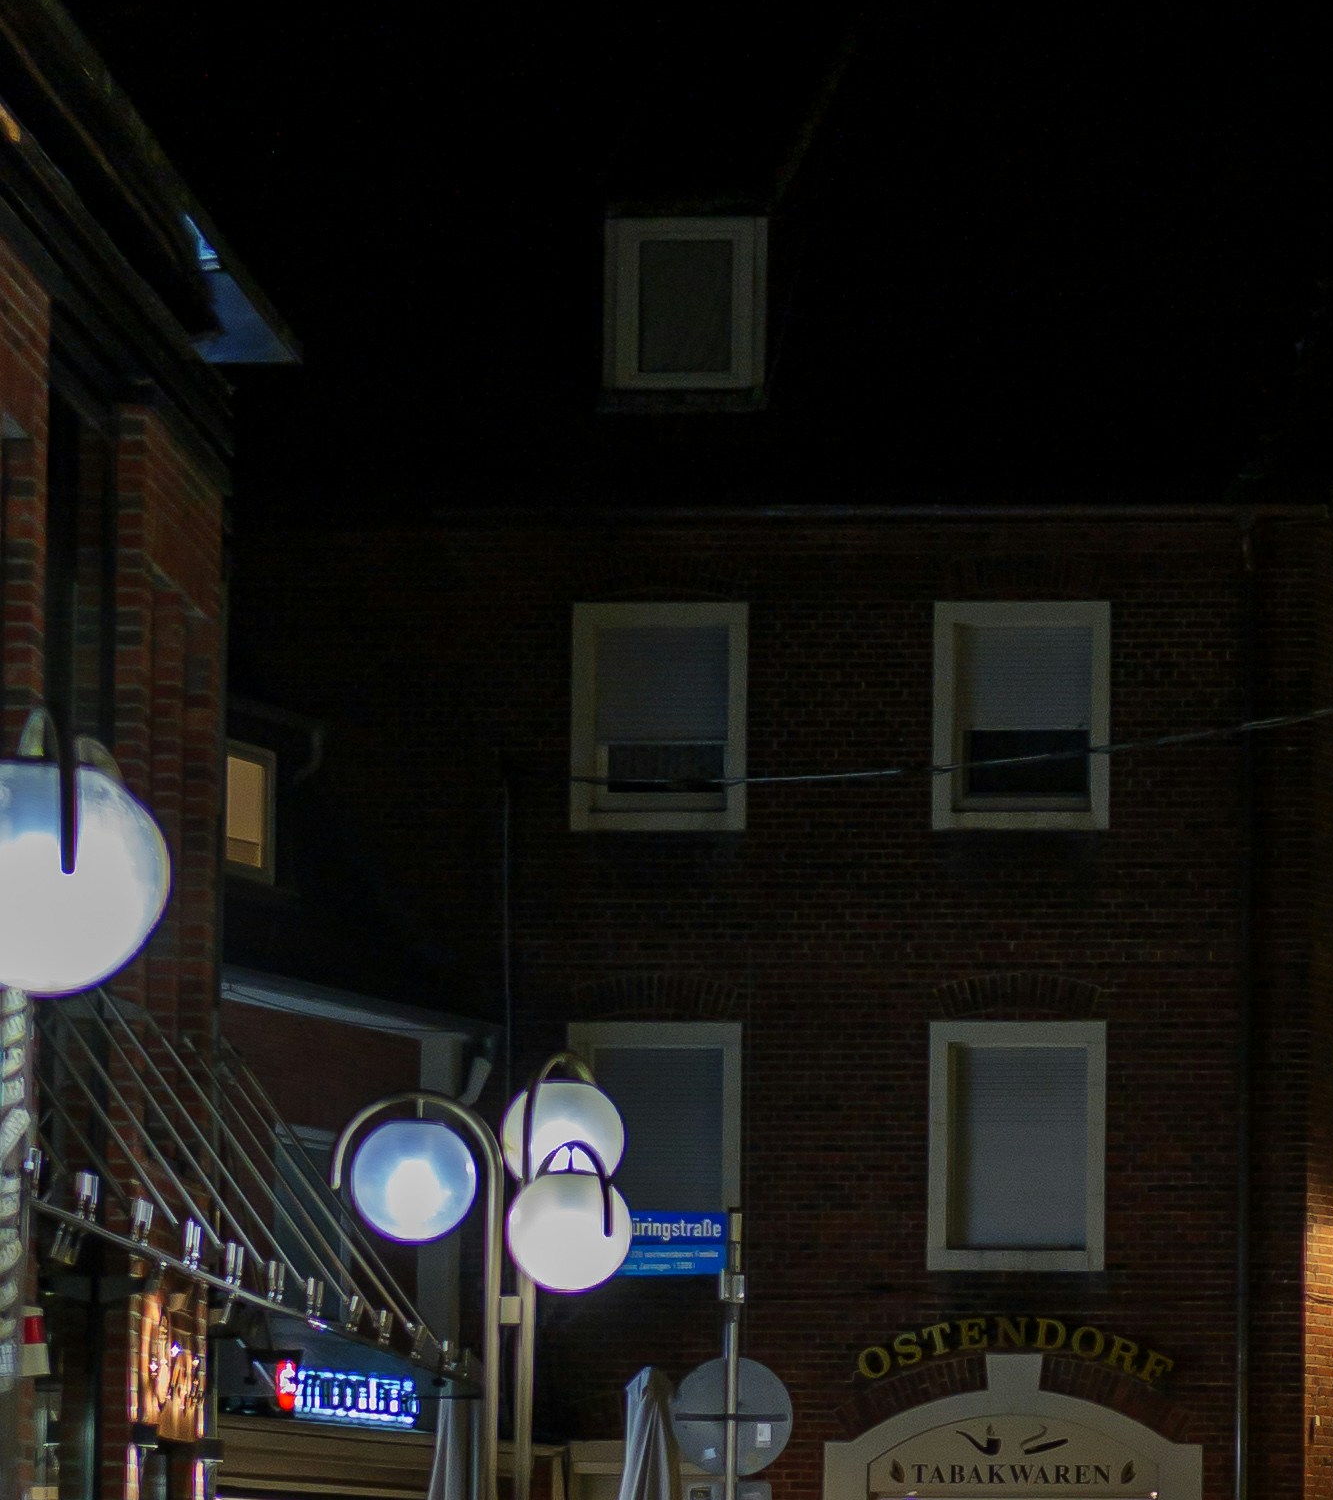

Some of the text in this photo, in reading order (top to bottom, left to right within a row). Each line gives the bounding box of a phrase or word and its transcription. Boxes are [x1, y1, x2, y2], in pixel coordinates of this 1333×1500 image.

[632, 1218, 722, 1241] üringstraße
[857, 1315, 1175, 1383] OSTENDORF
[911, 1463, 1112, 1485] TABAKWAREN
